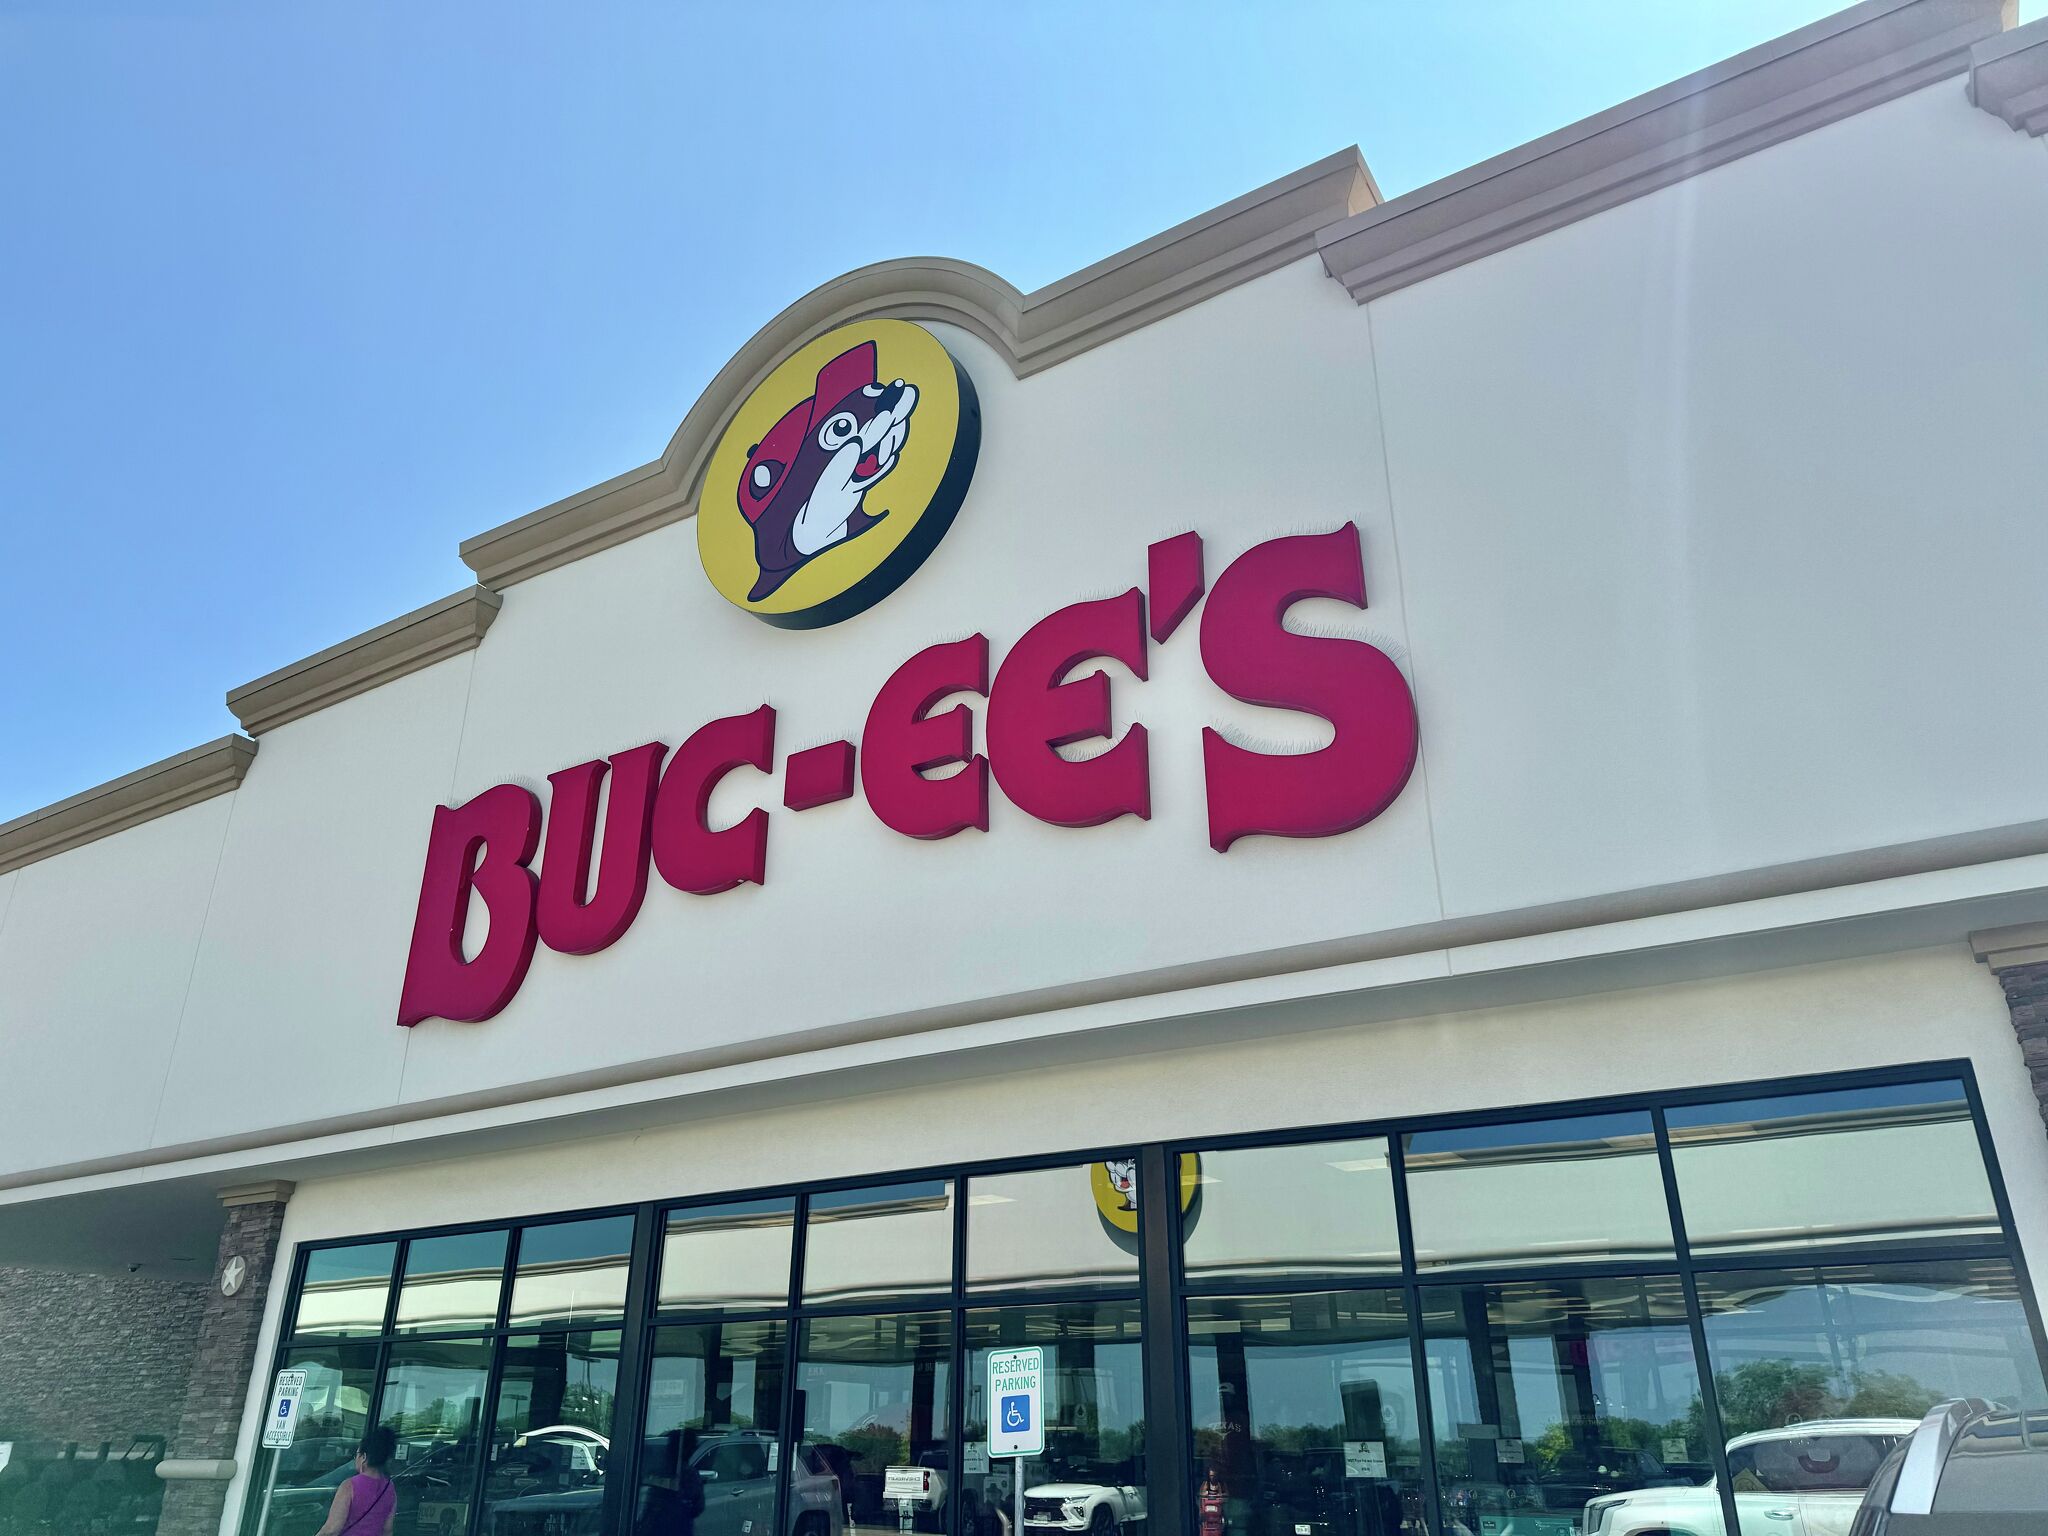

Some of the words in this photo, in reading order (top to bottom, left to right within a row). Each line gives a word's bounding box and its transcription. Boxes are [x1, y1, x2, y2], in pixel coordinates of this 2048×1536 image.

[397, 520, 1419, 1028] BUC-EE'S
[992, 1357, 1040, 1375] RESERVED
[279, 1376, 303, 1386] RESERVED
[995, 1375, 1036, 1392] PARKING
[278, 1386, 299, 1396] PARKING
[276, 1420, 287, 1430] VAN
[266, 1431, 292, 1441] ACCESSIBLE
